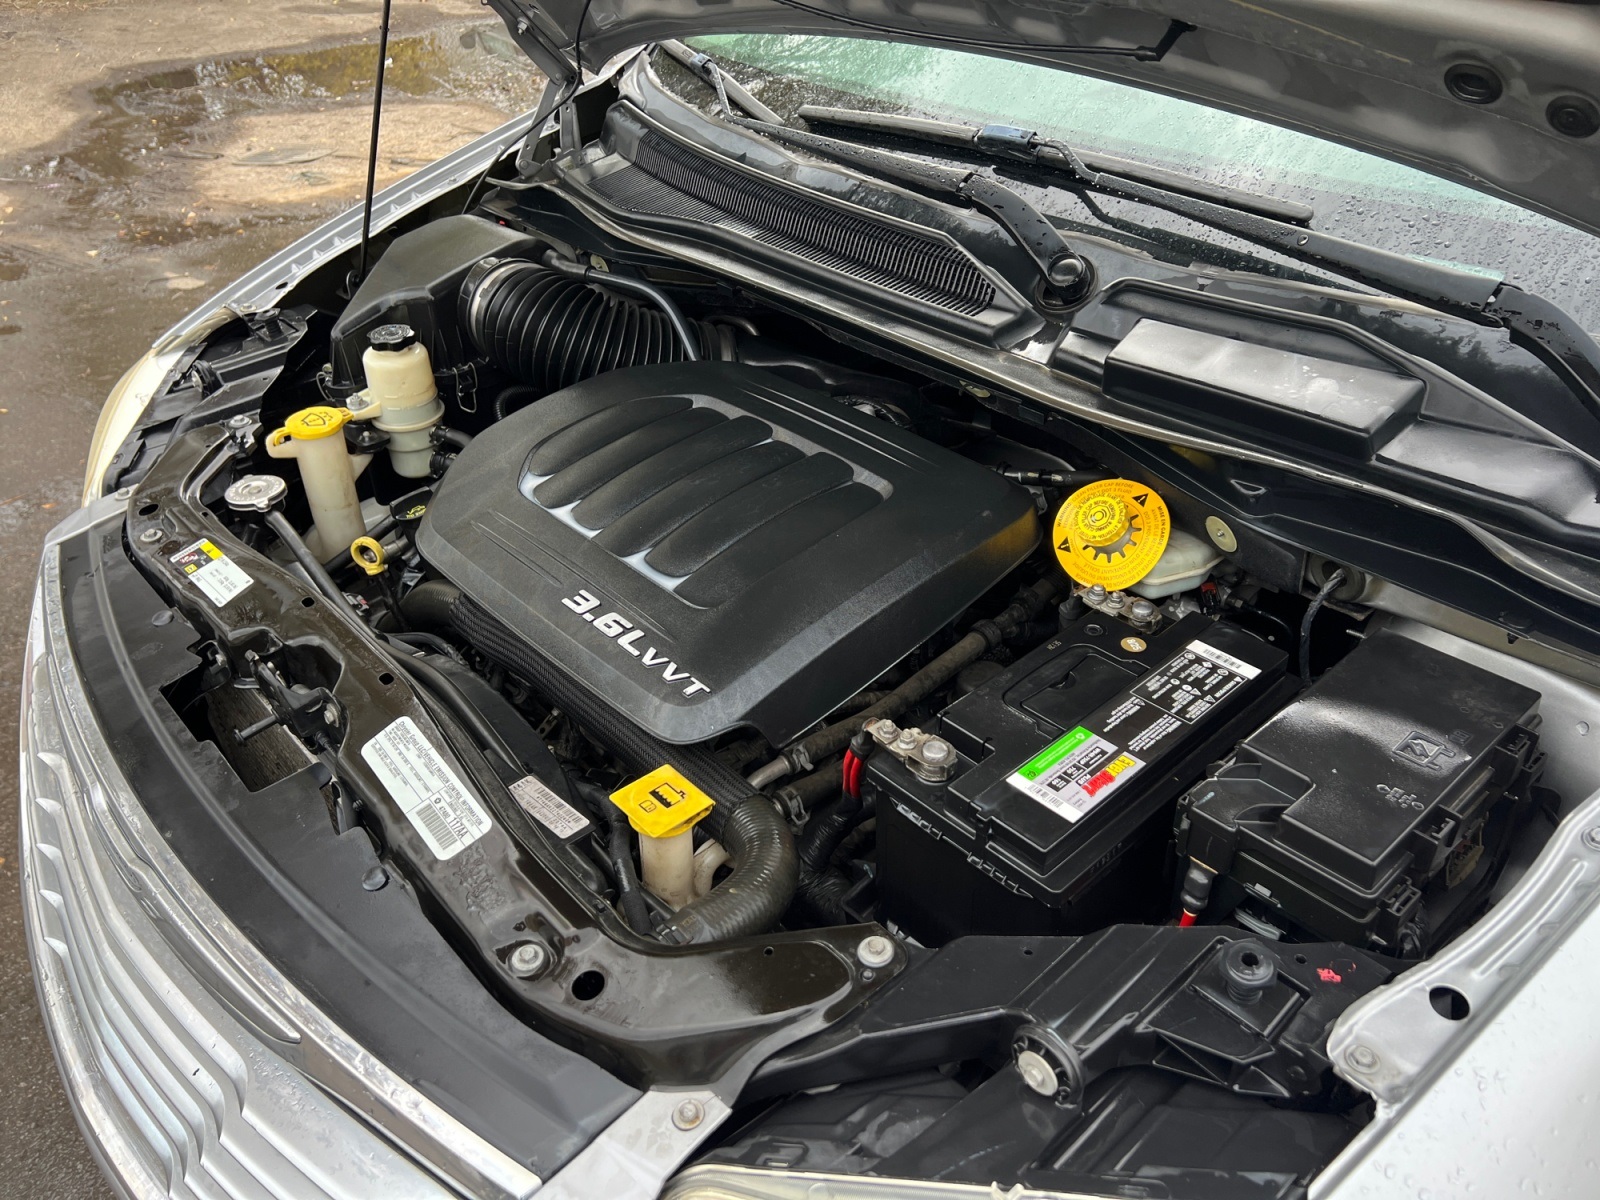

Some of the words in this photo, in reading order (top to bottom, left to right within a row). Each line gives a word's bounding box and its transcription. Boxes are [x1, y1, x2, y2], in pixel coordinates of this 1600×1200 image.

[1086, 483, 1103, 492] FILLER
[1115, 481, 1133, 489] BEFORE
[1117, 487, 1132, 495] FLUID
[1084, 502, 1093, 510] CAP
[1157, 505, 1166, 518] MISE
[1152, 509, 1160, 522] AVANT
[641, 646, 711, 698] VVT
[400, 720, 411, 737] Chrysler
[417, 744, 426, 753] LLC
[1077, 773, 1092, 785] PLUS
[1081, 755, 1136, 797] EverStart
[423, 751, 437, 767] VEHICLE
[435, 766, 450, 784] EMISSION
[448, 783, 463, 800] CONTROL
[461, 799, 483, 825] INFORMATION
[449, 817, 468, 838] 117AA
